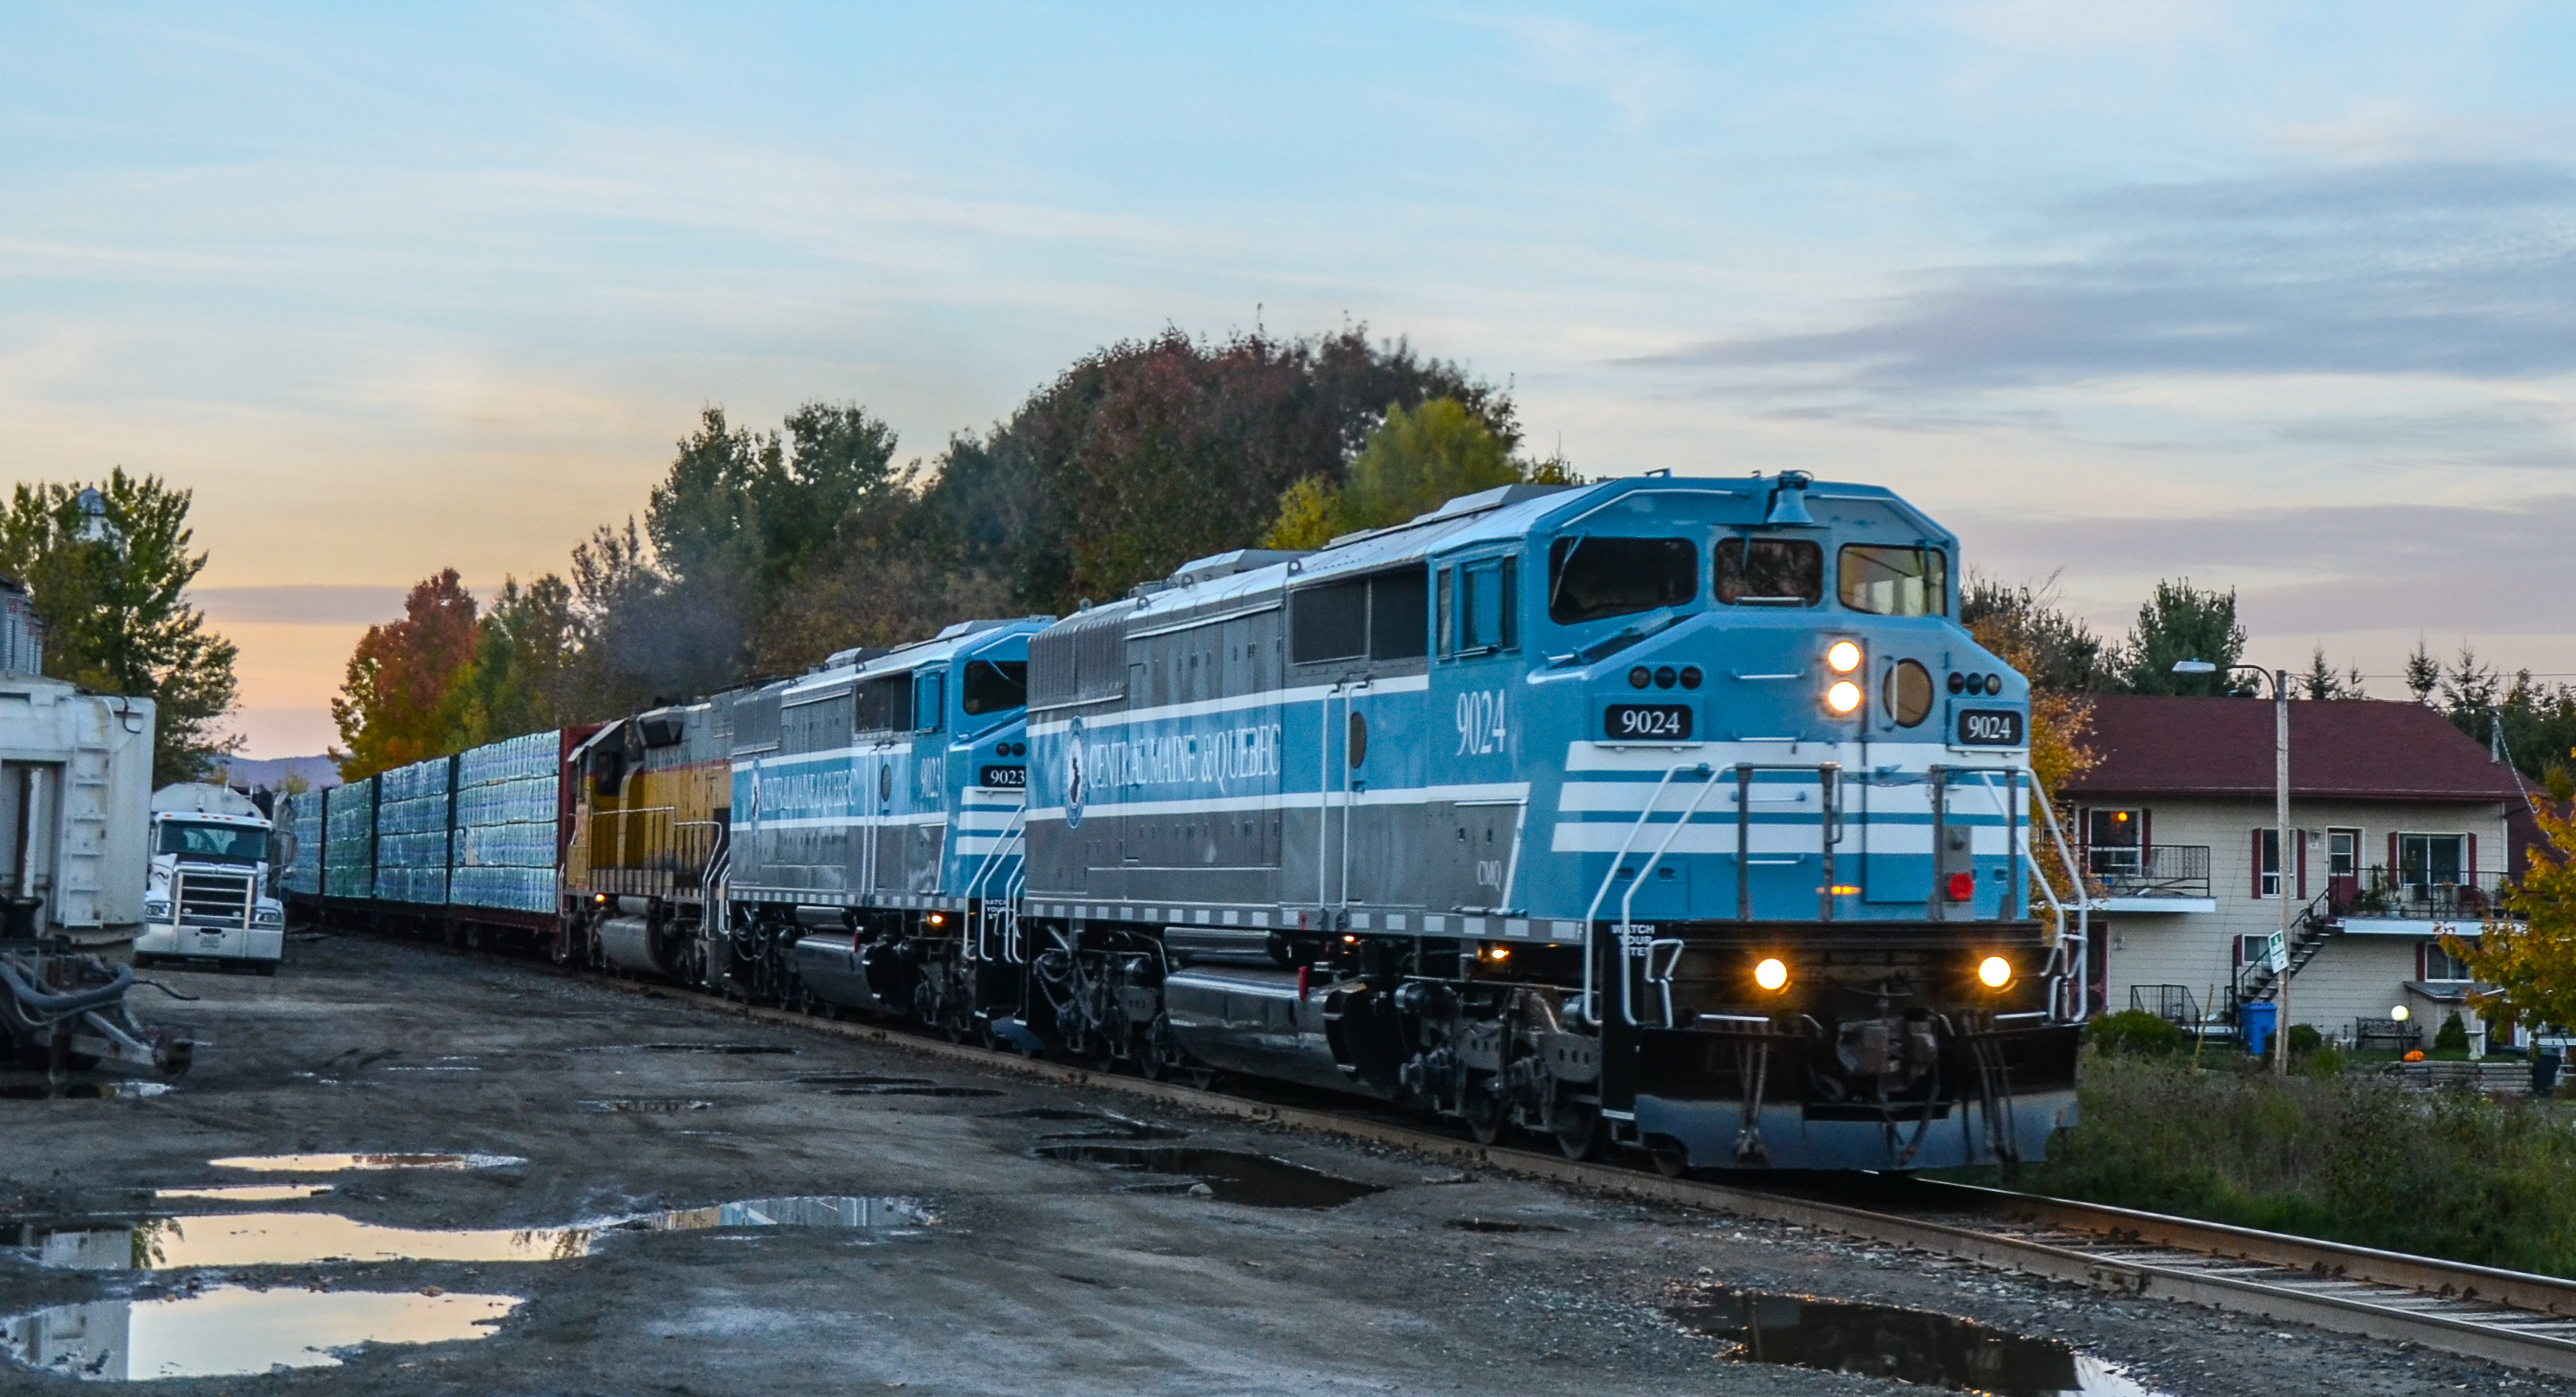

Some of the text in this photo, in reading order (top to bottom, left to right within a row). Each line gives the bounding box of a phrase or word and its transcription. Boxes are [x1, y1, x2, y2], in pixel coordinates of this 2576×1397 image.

[1456, 689, 1506, 756] 9024
[1622, 710, 1680, 733] 9024
[1968, 715, 2011, 739] 9024
[1089, 739, 1147, 788] CENTRAL
[1150, 734, 1197, 784] MAINE
[1201, 734, 1213, 783] &
[1214, 724, 1281, 794] QUEBEC
[990, 769, 1026, 784] 9023
[1623, 946, 1650, 956] TE
